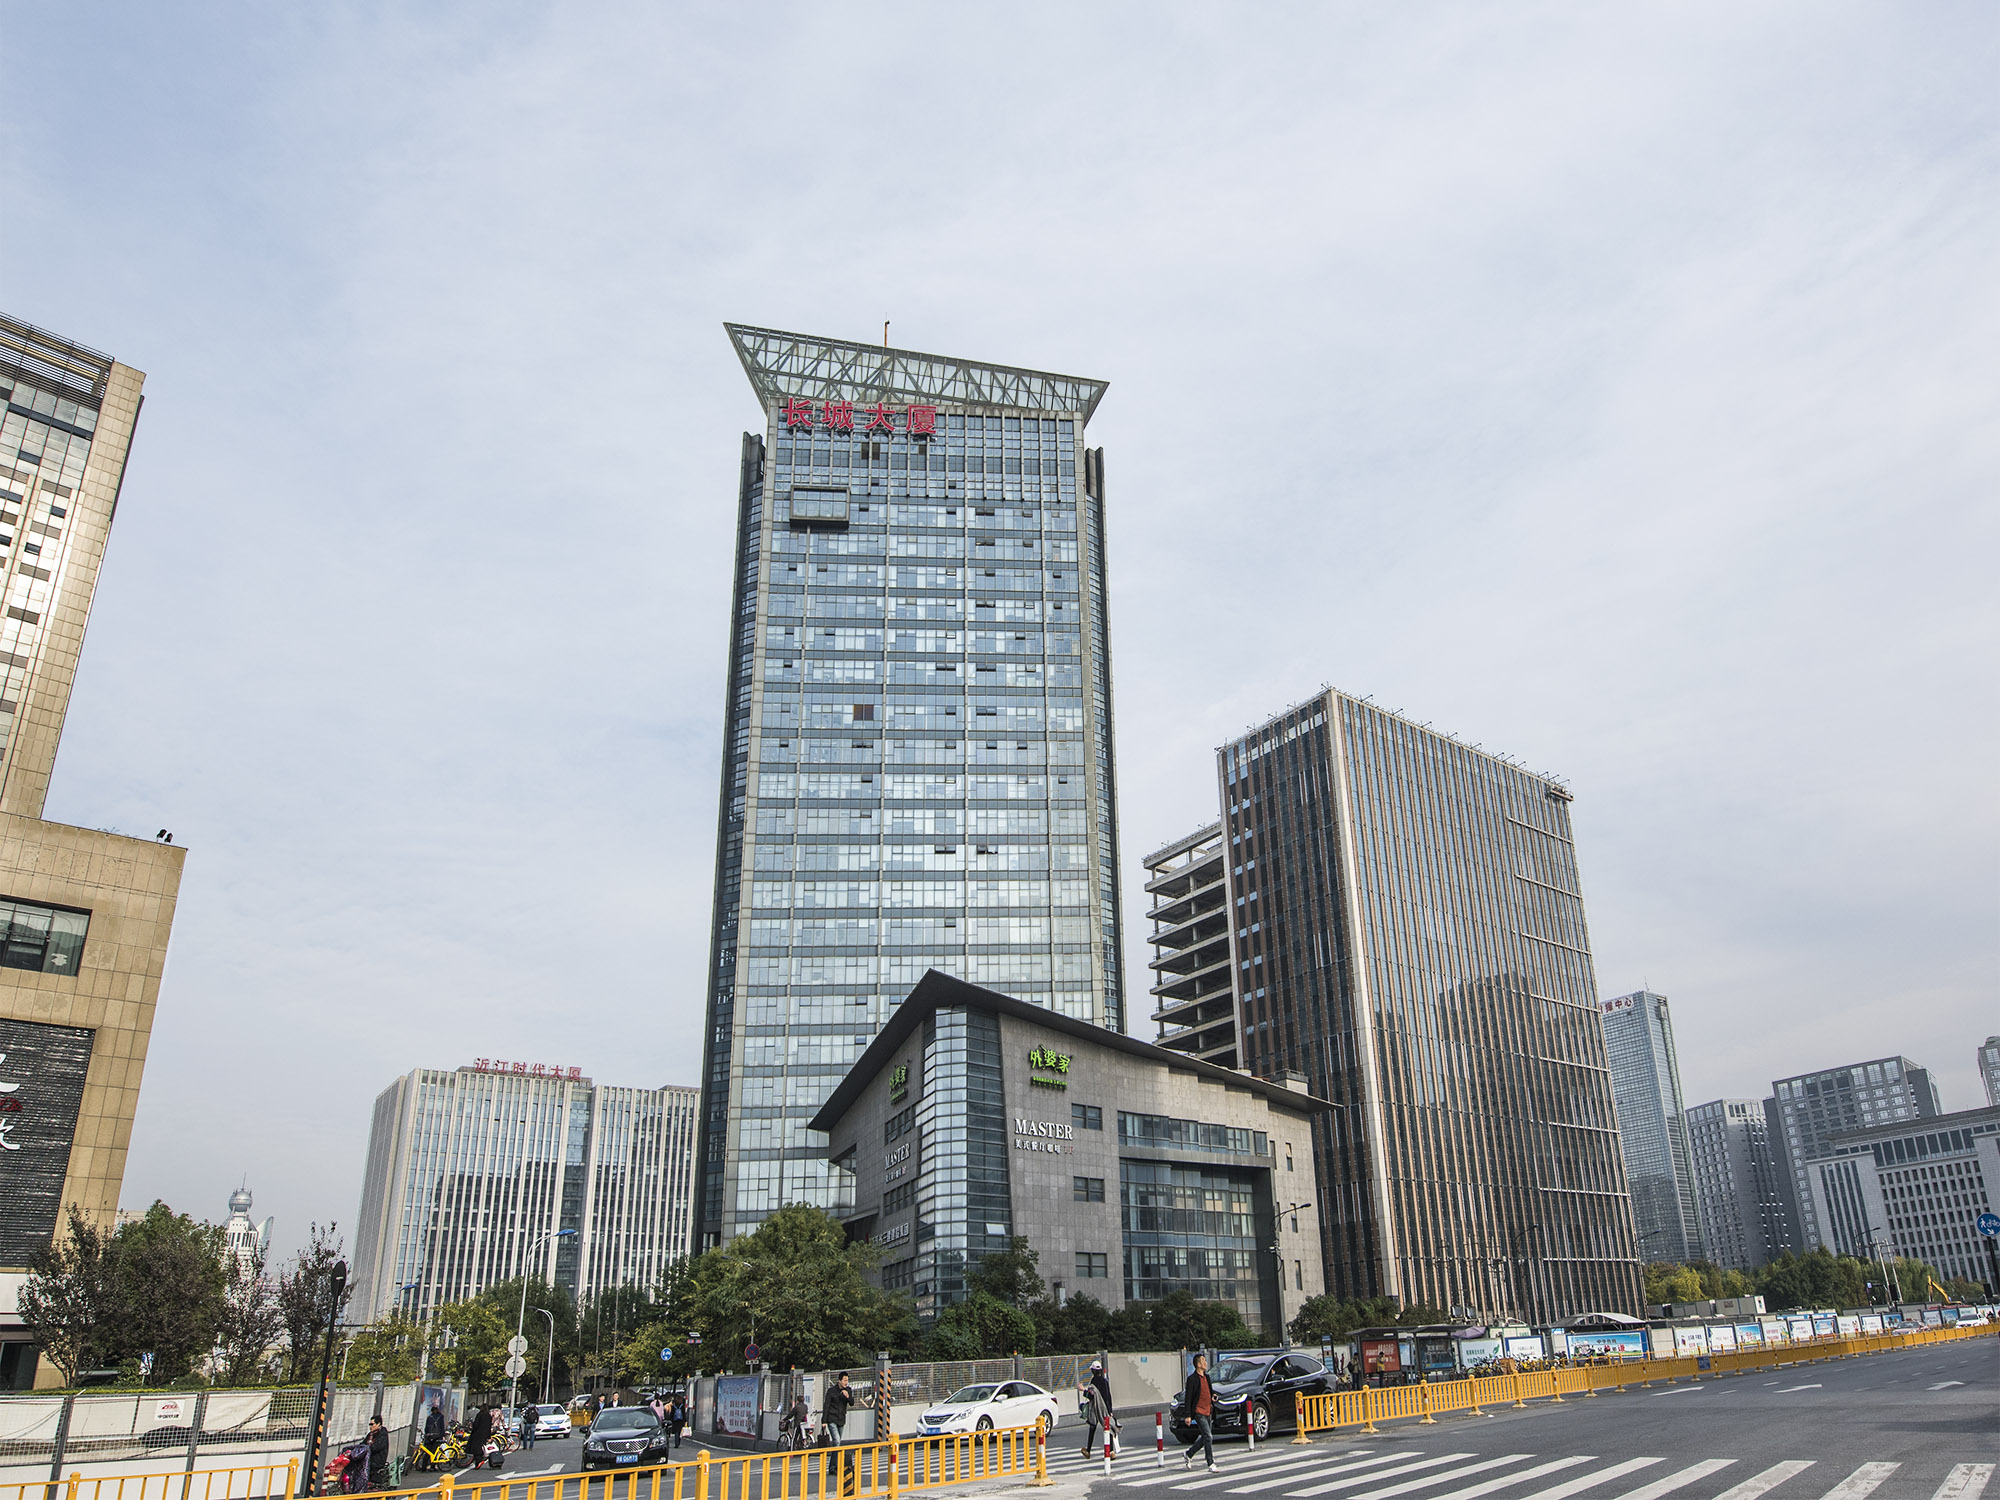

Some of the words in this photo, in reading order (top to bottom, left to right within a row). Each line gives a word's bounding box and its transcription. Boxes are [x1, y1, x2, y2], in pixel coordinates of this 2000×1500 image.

[781, 397, 937, 435] 长城大厦
[1600, 998, 1632, 1014] 中心
[475, 1058, 583, 1081] 近江时代大厦
[1030, 1046, 1071, 1073] 外婆家
[1015, 1118, 1073, 1140] MASTER
[885, 1143, 910, 1170] MASTER
